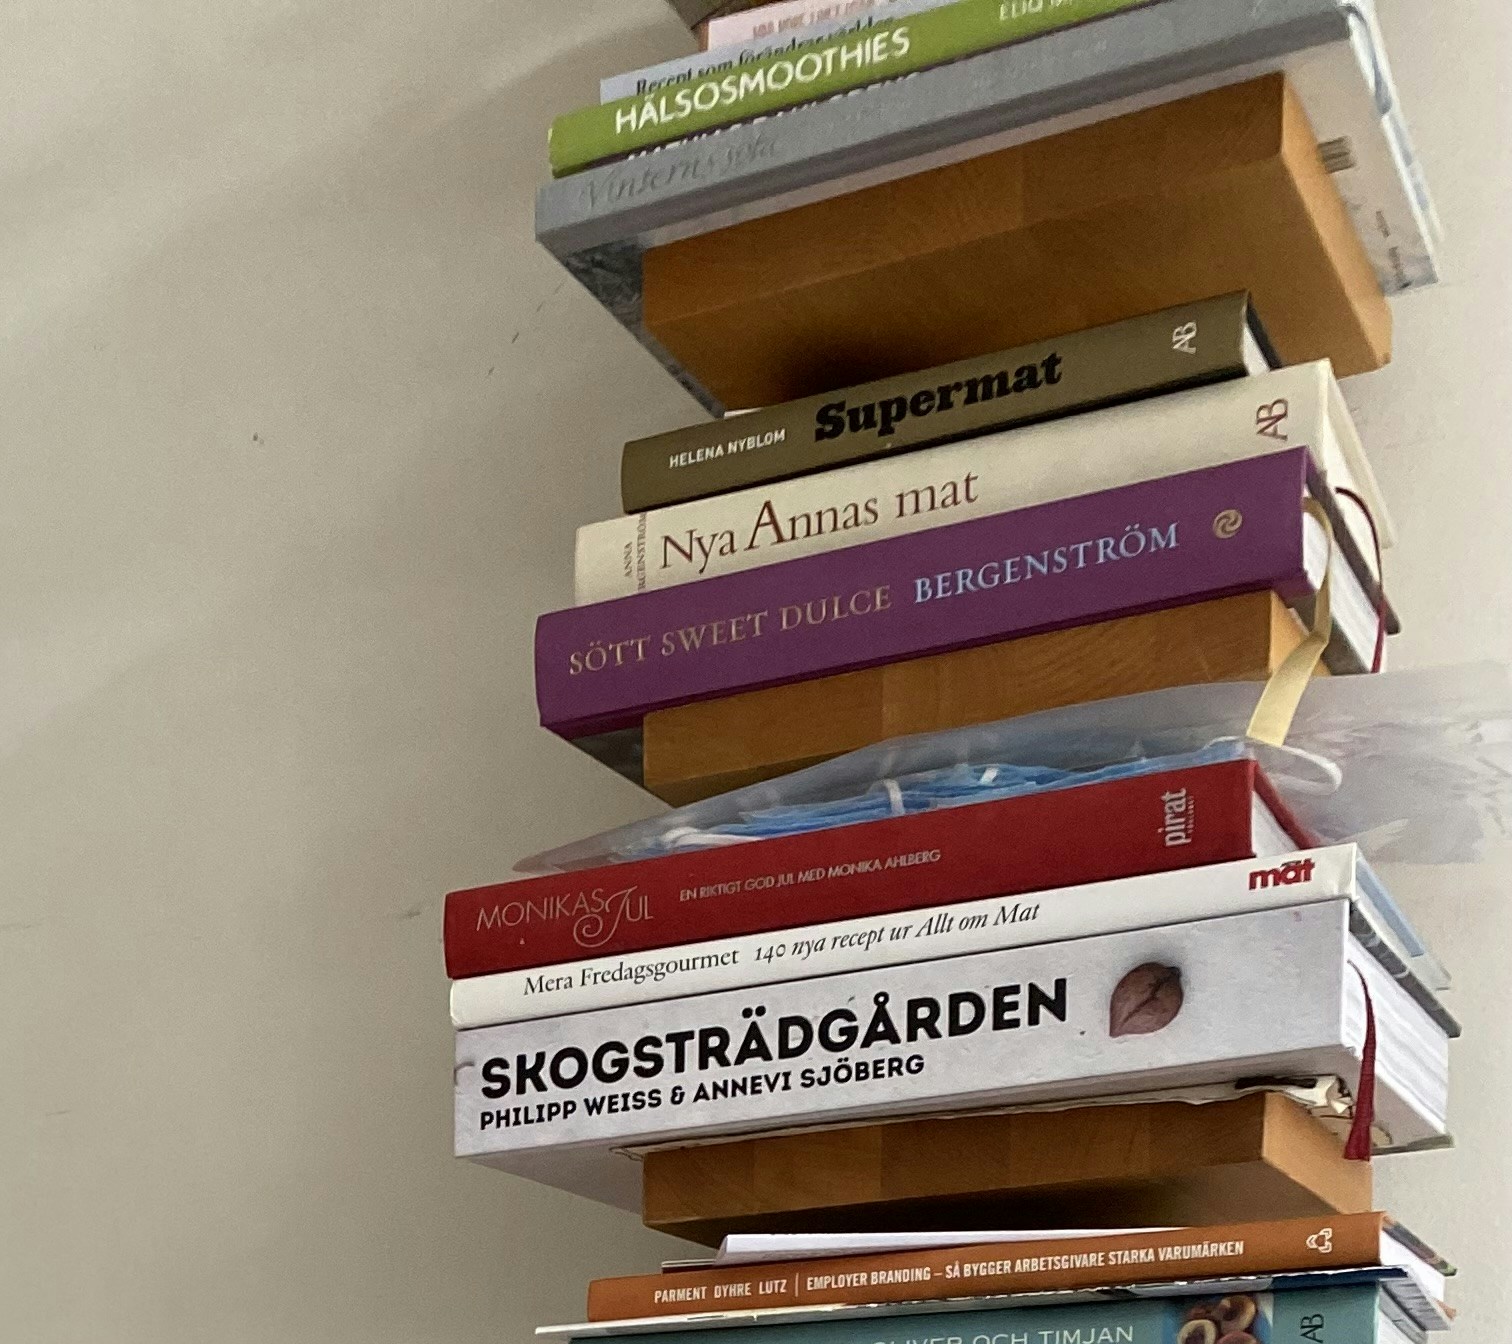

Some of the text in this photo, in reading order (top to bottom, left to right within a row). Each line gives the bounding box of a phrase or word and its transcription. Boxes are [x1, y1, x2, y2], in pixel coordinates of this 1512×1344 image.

[615, 27, 910, 135] HÄLSOSMOOTHIES
[814, 351, 1063, 442] Supermat
[669, 428, 786, 469] HELENA NYBLOM
[624, 542, 633, 577] ANNA
[660, 471, 980, 574] Nya Annas mat
[914, 521, 1180, 604] BERGENSTRÖM
[569, 585, 893, 676] SÖTT SWEET DULCE
[1158, 787, 1188, 848] pirat
[680, 848, 941, 902] EN RIKTIGT GOD JUL MED MONIKA AHLBERG
[475, 885, 654, 948] MONIKAS JUL
[523, 902, 1041, 997] Mera Fredagsgourmet 140 nya recept ur Allt om Mat
[482, 977, 1067, 1099] SKOGSTRÄDGÅRDEN
[480, 1055, 924, 1131] PHILIPP WEISS & ANNEVI SJÖBERG
[654, 1279, 787, 1304] PARMENT DYHRE LUTZ
[806, 1240, 1244, 1292] EMPLOYER BRANDING SÅ BYGGER ARBETSGIVARE STARKA VARUMÄRKEN
